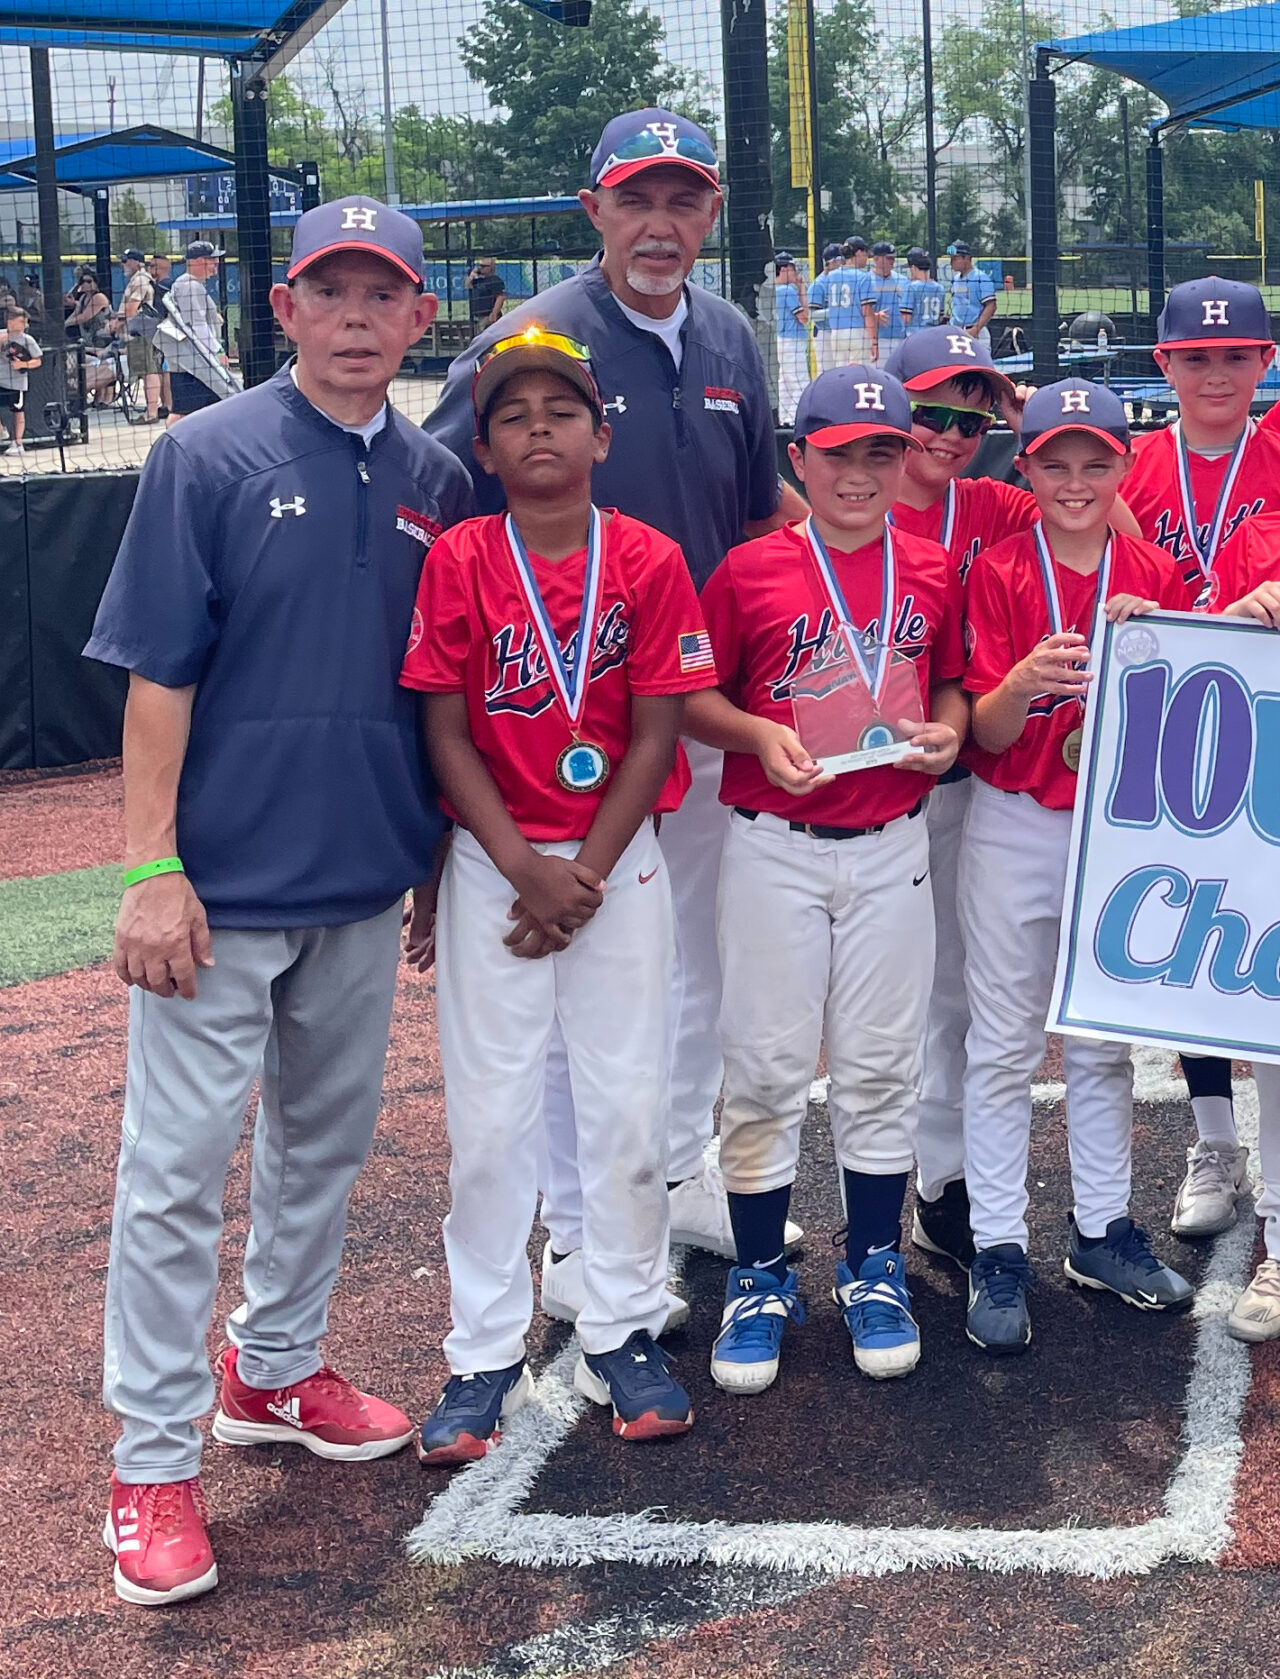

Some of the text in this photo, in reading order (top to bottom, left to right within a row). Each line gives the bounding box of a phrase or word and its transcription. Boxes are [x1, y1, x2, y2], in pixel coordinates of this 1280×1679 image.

[341, 207, 378, 231] H
[830, 282, 852, 308] 13
[922, 295, 941, 321] 19
[1201, 299, 1230, 327] H
[946, 334, 977, 358] H
[853, 382, 886, 412] H
[1060, 389, 1091, 414] H
